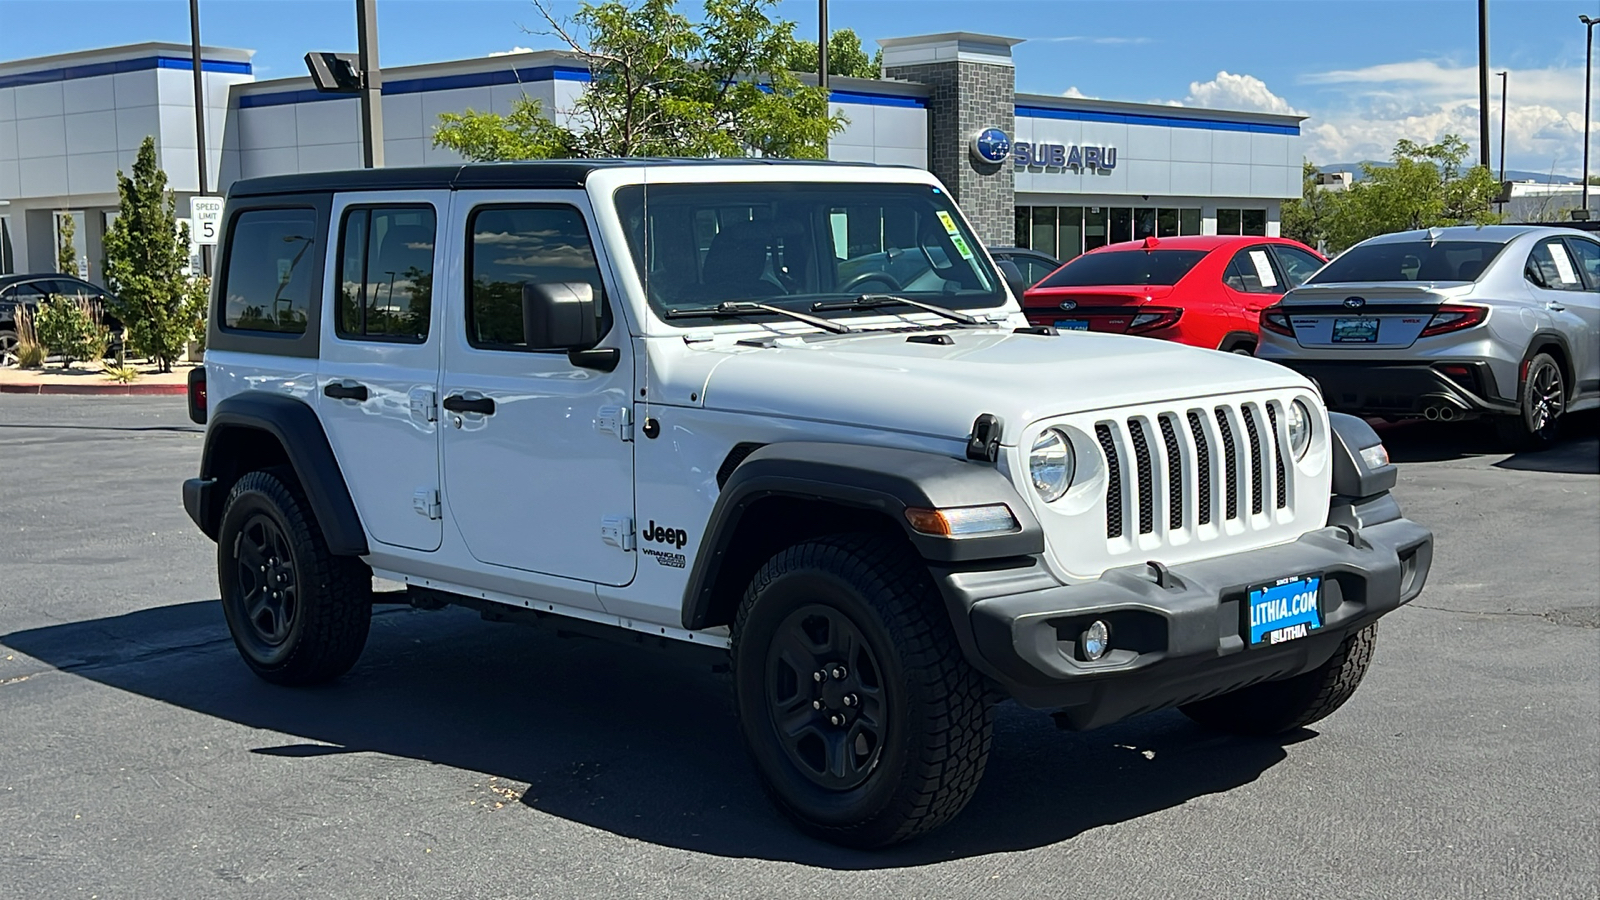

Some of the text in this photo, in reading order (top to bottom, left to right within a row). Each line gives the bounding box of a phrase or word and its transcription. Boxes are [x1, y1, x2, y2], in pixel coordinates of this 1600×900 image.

[1014, 142, 1117, 170] SUBARU
[203, 222, 215, 238] 5
[642, 519, 688, 550] Jeep
[642, 548, 686, 559] WRANGLER
[1250, 589, 1318, 628] LITHIA.COM
[1278, 624, 1308, 642] LITHIA
